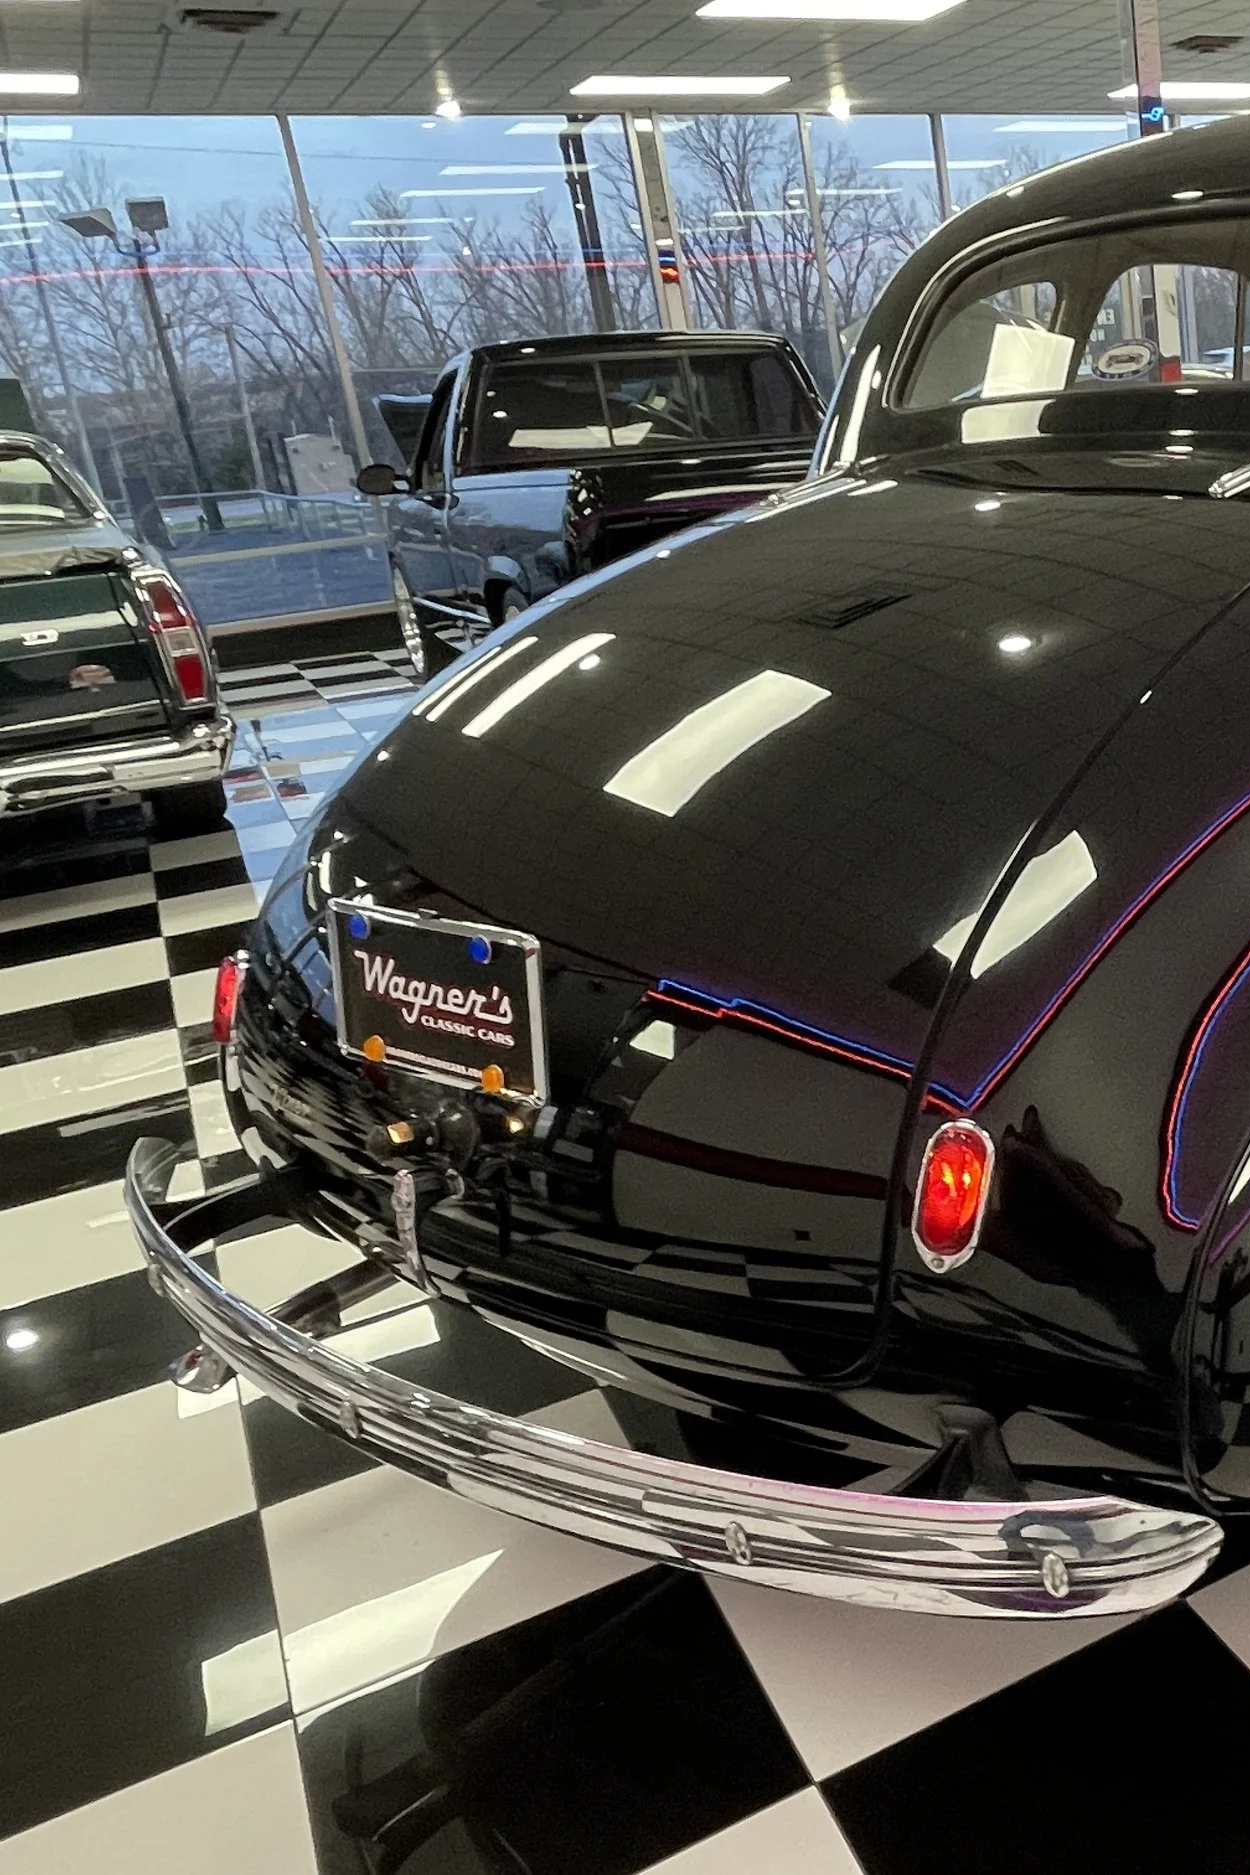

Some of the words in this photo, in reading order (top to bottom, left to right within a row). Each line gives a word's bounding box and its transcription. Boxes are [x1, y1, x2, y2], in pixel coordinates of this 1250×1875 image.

[354, 950, 513, 1024] Wagner's
[421, 1015, 475, 1037] CLASSIC
[477, 1028, 515, 1046] CARS
